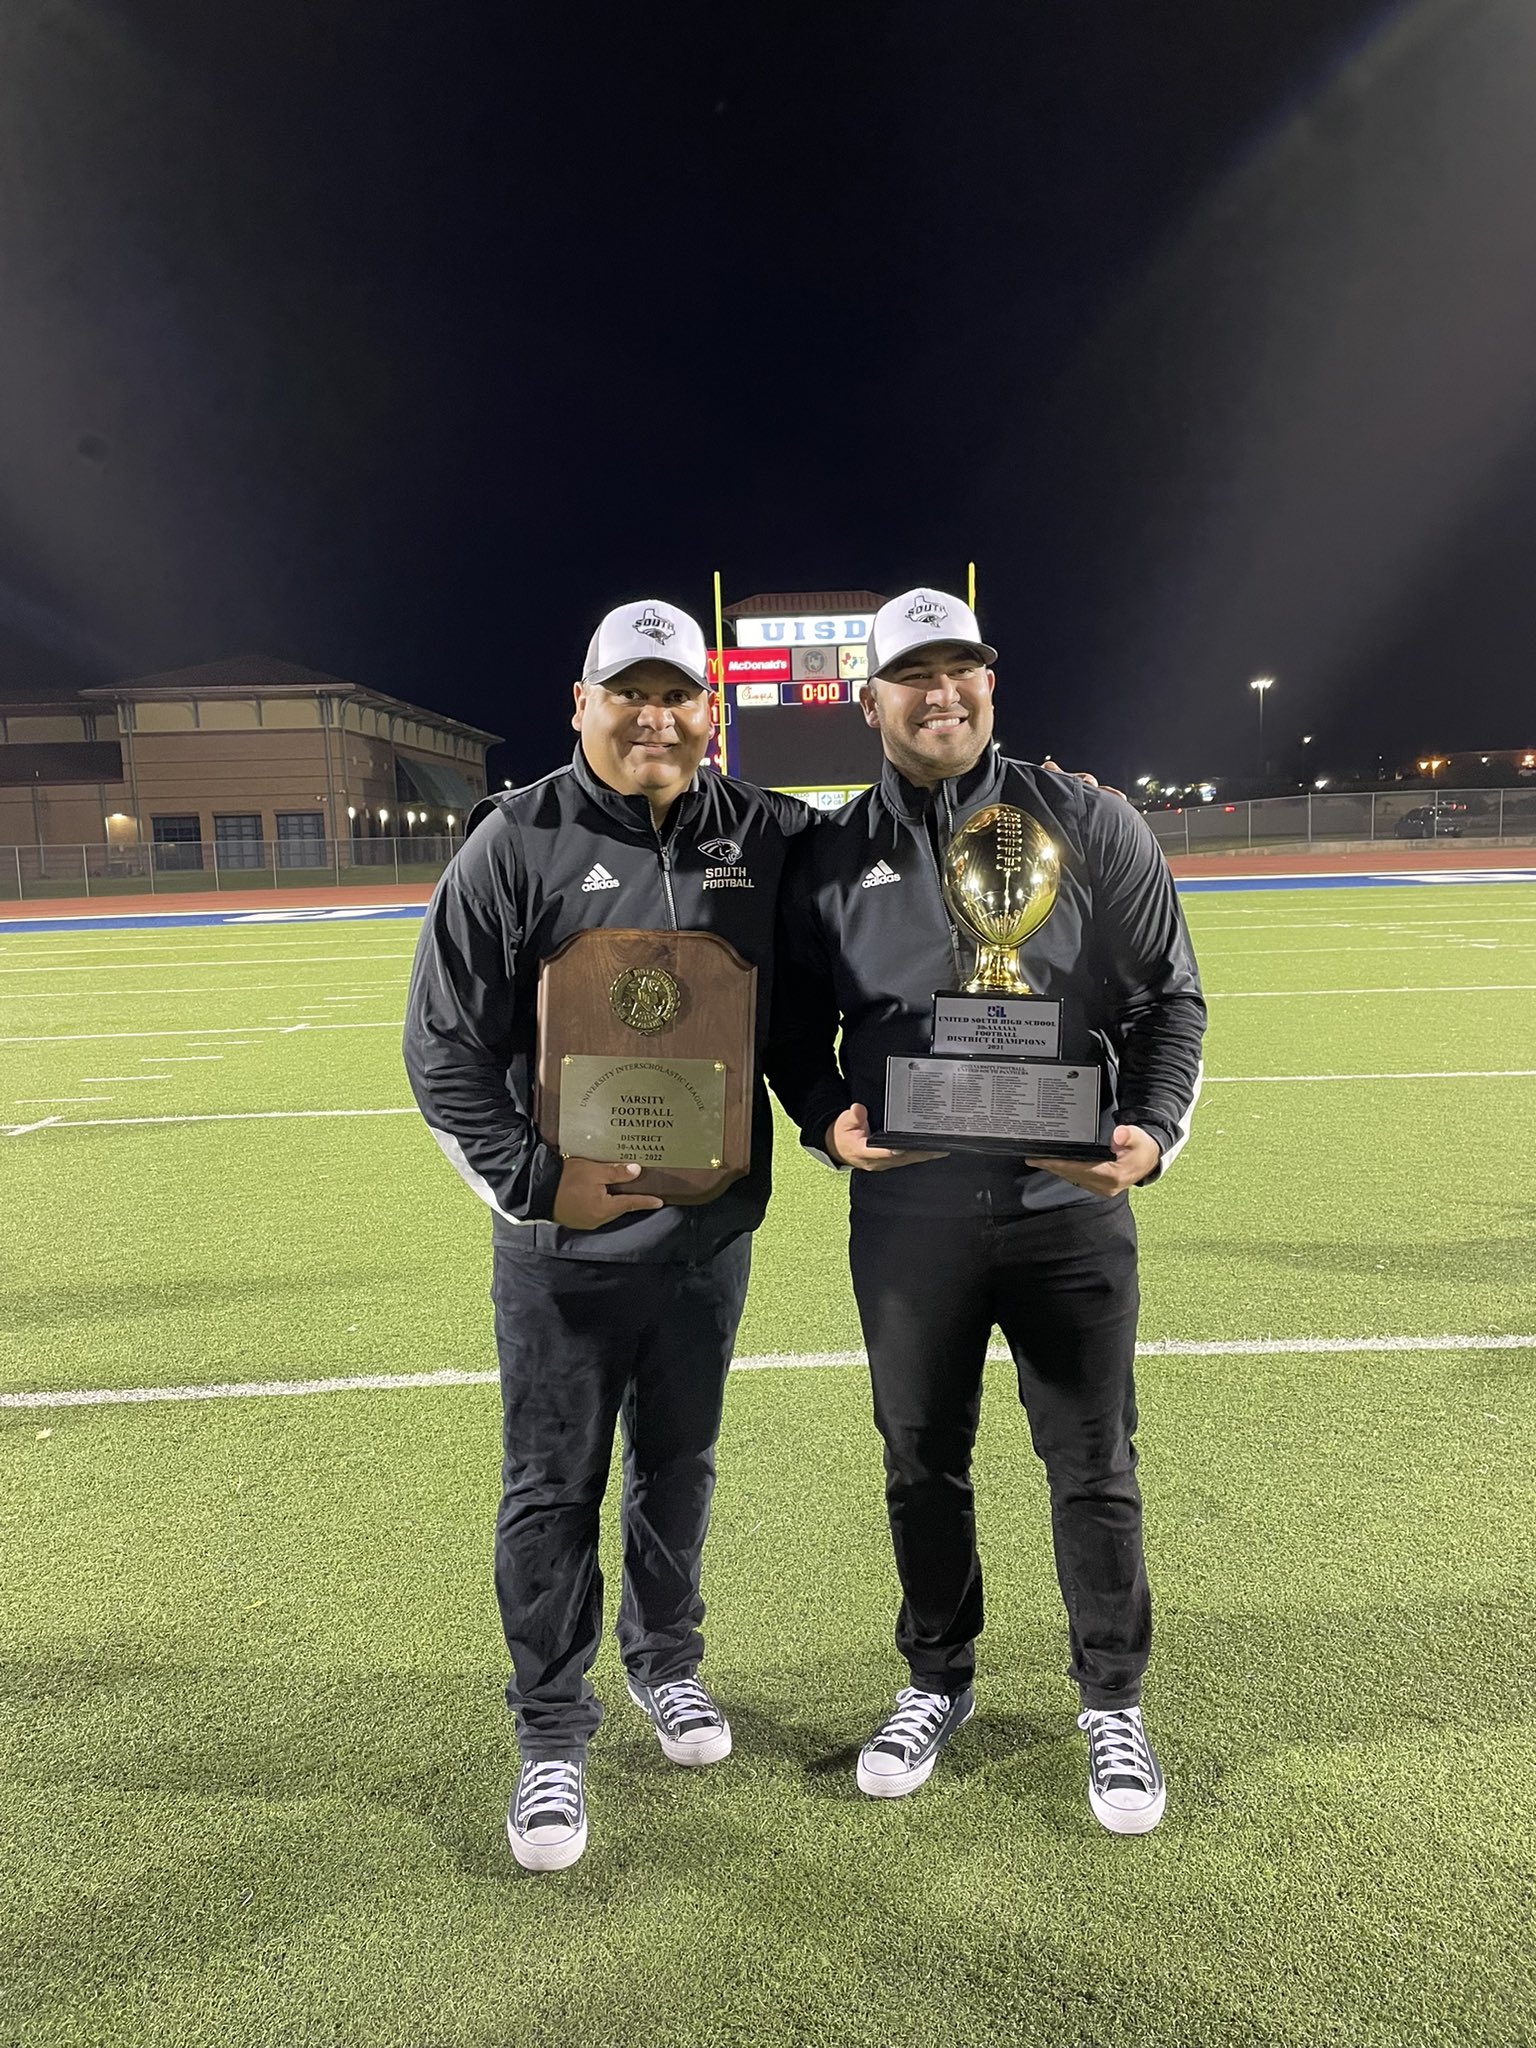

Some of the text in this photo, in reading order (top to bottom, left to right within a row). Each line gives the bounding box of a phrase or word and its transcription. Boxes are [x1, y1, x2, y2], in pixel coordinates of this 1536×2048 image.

[908, 604, 946, 617] SOUTH
[635, 618, 675, 630] SOUTH
[761, 620, 866, 641] UISD
[728, 659, 787, 671] McDonald's
[802, 683, 840, 701] 0:00
[705, 867, 747, 879] SOUTH
[581, 879, 620, 892] adidas
[703, 879, 755, 890] FOOTBALL
[862, 873, 901, 888] adidas
[1000, 1018, 1022, 1026] HIGH
[975, 1030, 1018, 1038] FOOTBALL
[946, 1035, 1046, 1046] DISTRICT CHAMPIONS
[580, 1062, 705, 1112] UNIVERSITY INTERSCHOLASTIC LEAGUE
[620, 1095, 666, 1105] VARSITY
[611, 1106, 674, 1117] FOOTBALL
[610, 1118, 674, 1128] CHAMPION
[620, 1134, 663, 1142] DISTRICT
[644, 1153, 663, 1161] 2022
